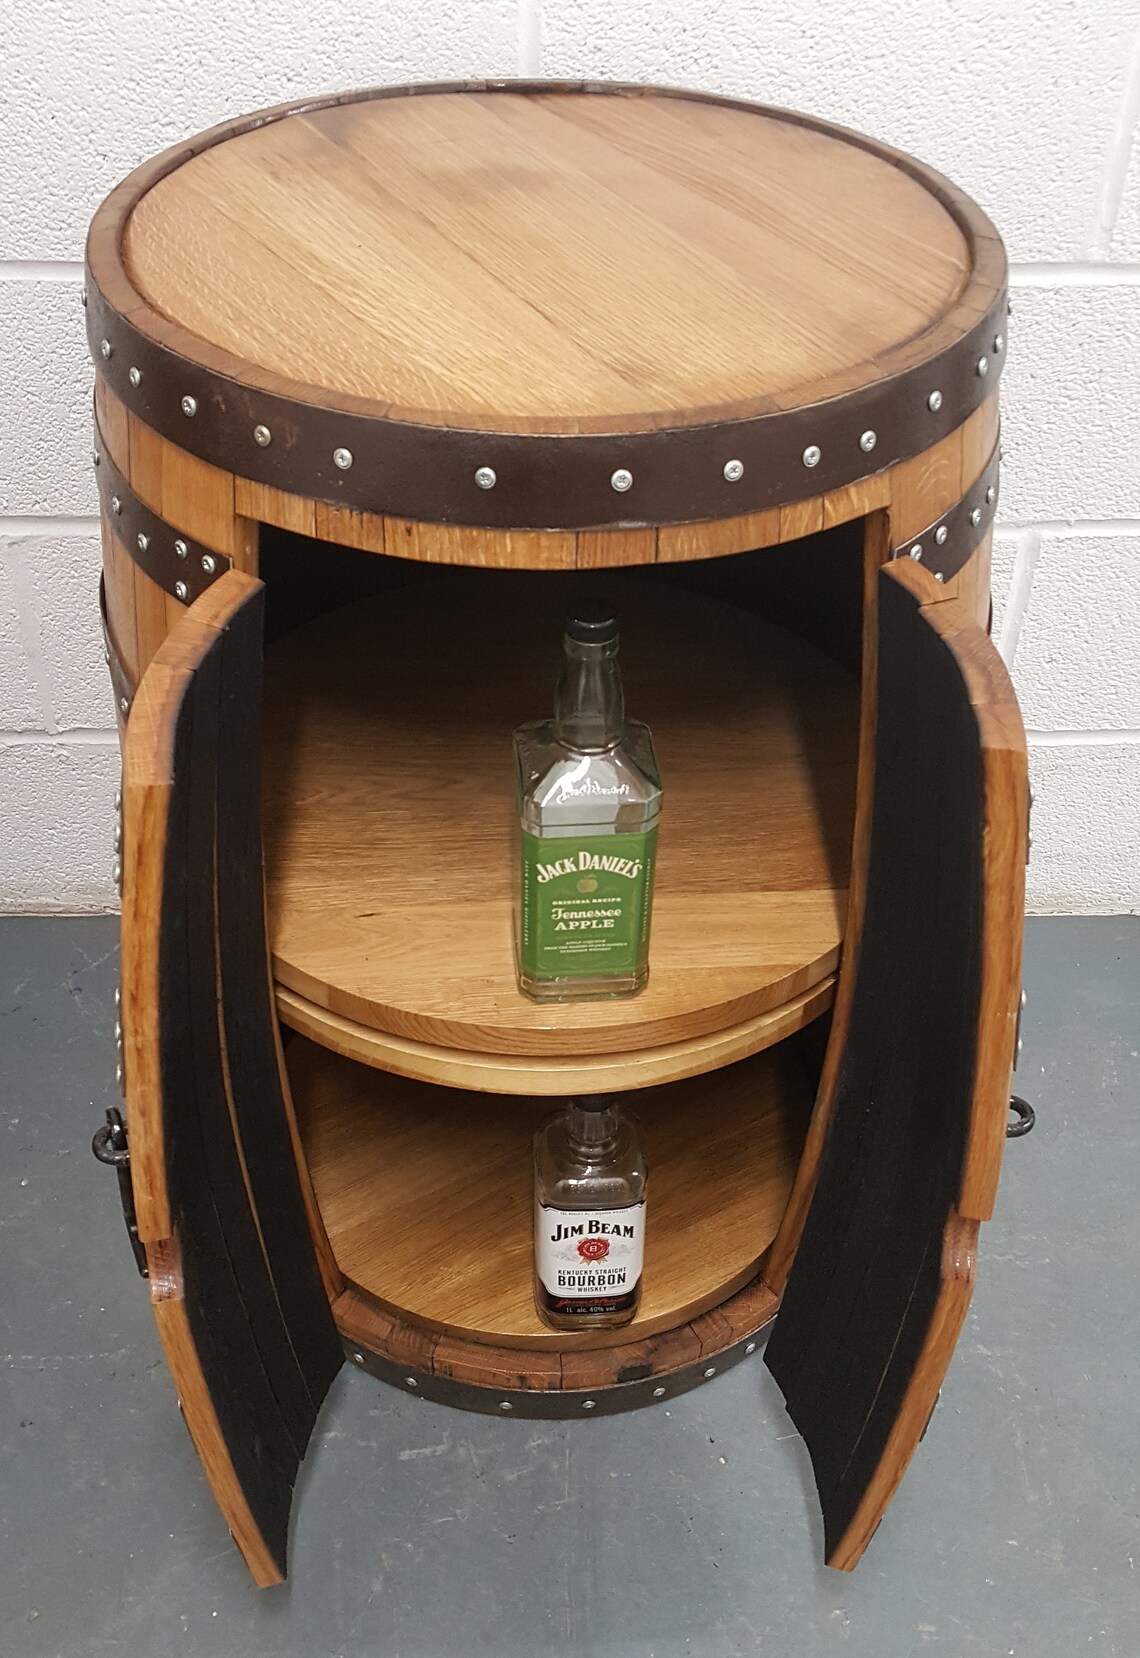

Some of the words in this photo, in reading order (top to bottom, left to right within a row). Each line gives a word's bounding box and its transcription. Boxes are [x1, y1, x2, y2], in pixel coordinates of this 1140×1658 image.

[536, 857, 577, 883] JACK
[578, 851, 643, 879] DANIEL'S
[551, 907, 622, 920] Tennessee
[554, 919, 615, 931] APPLE
[550, 1224, 584, 1242] JIM
[588, 1220, 634, 1238] BEAM
[595, 1266, 626, 1275] STRAIGHT
[558, 1273, 626, 1286] BOURBON
